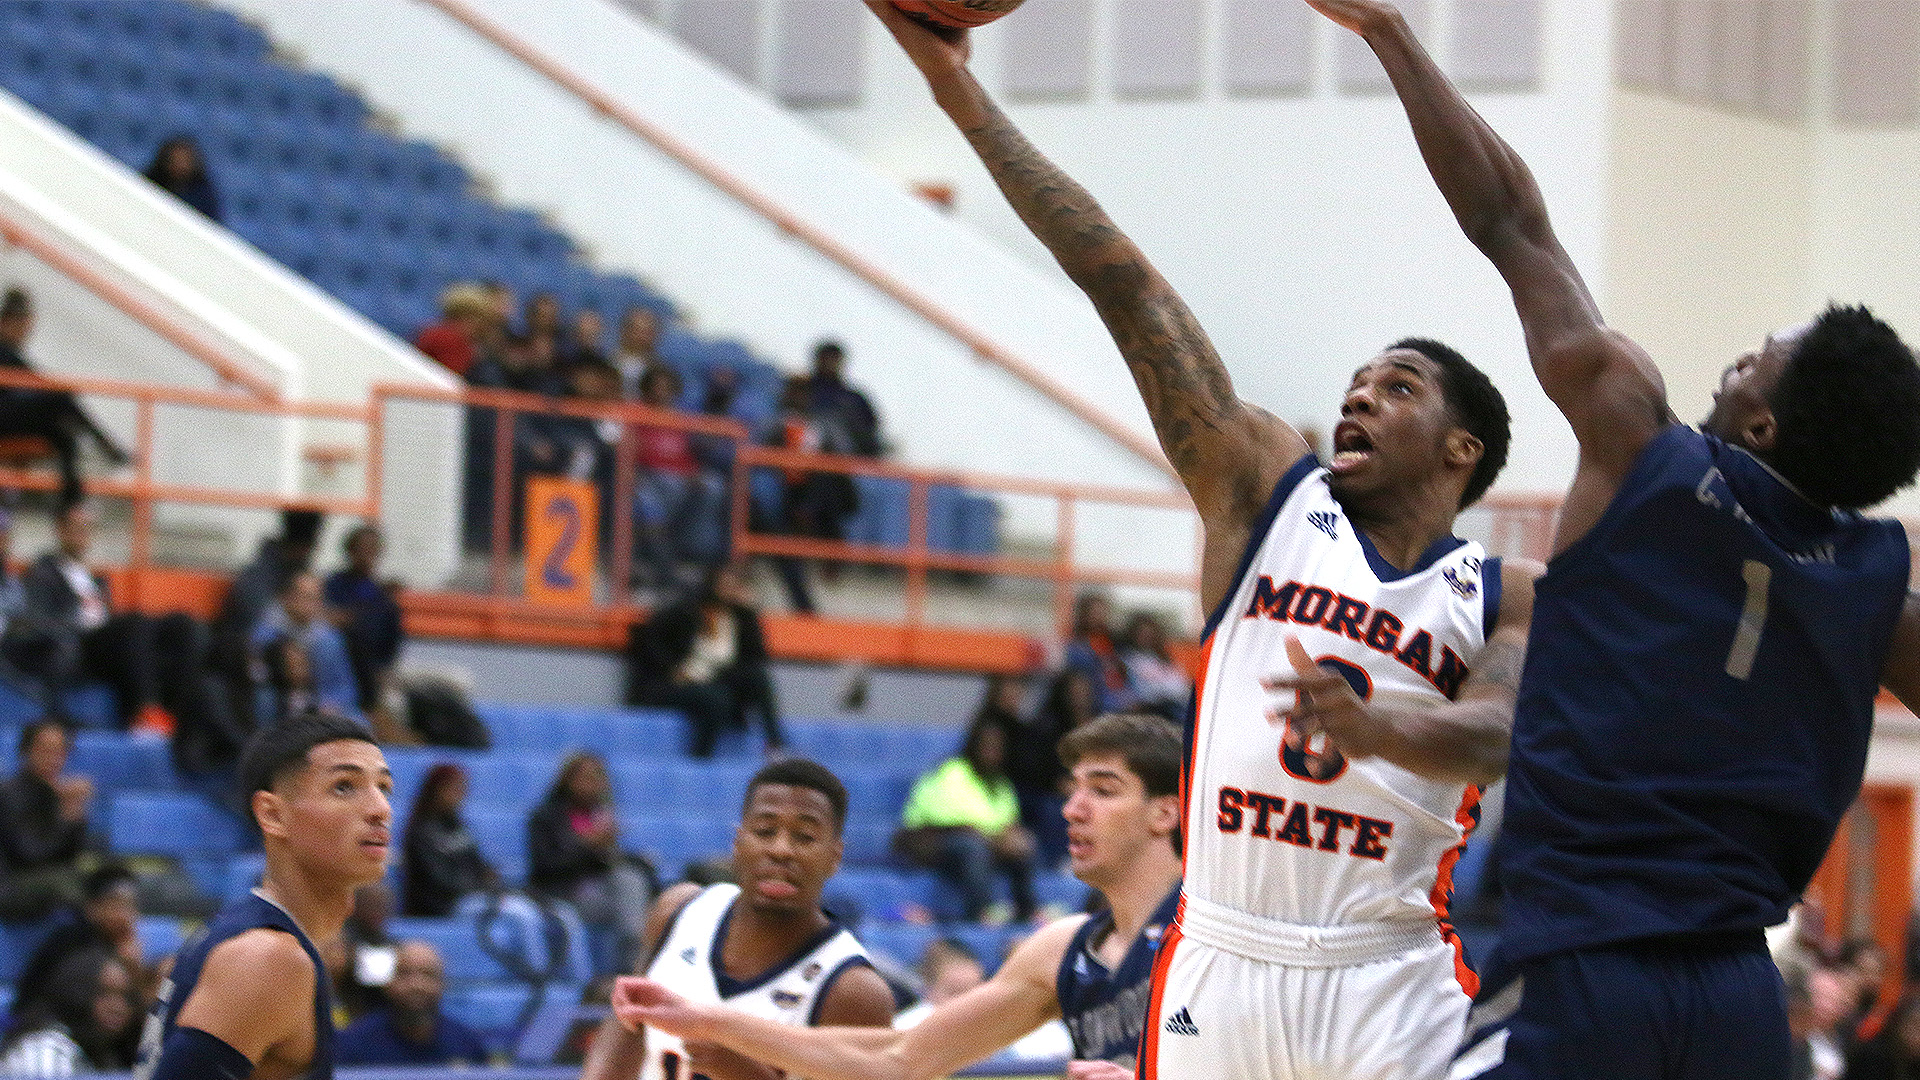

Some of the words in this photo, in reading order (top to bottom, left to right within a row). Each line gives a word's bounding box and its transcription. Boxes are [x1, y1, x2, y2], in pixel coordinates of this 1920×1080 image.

[541, 495, 581, 588] 2
[1242, 574, 1471, 704] MORGAN
[1725, 559, 1772, 680] 1
[1217, 785, 1394, 861] STATE
